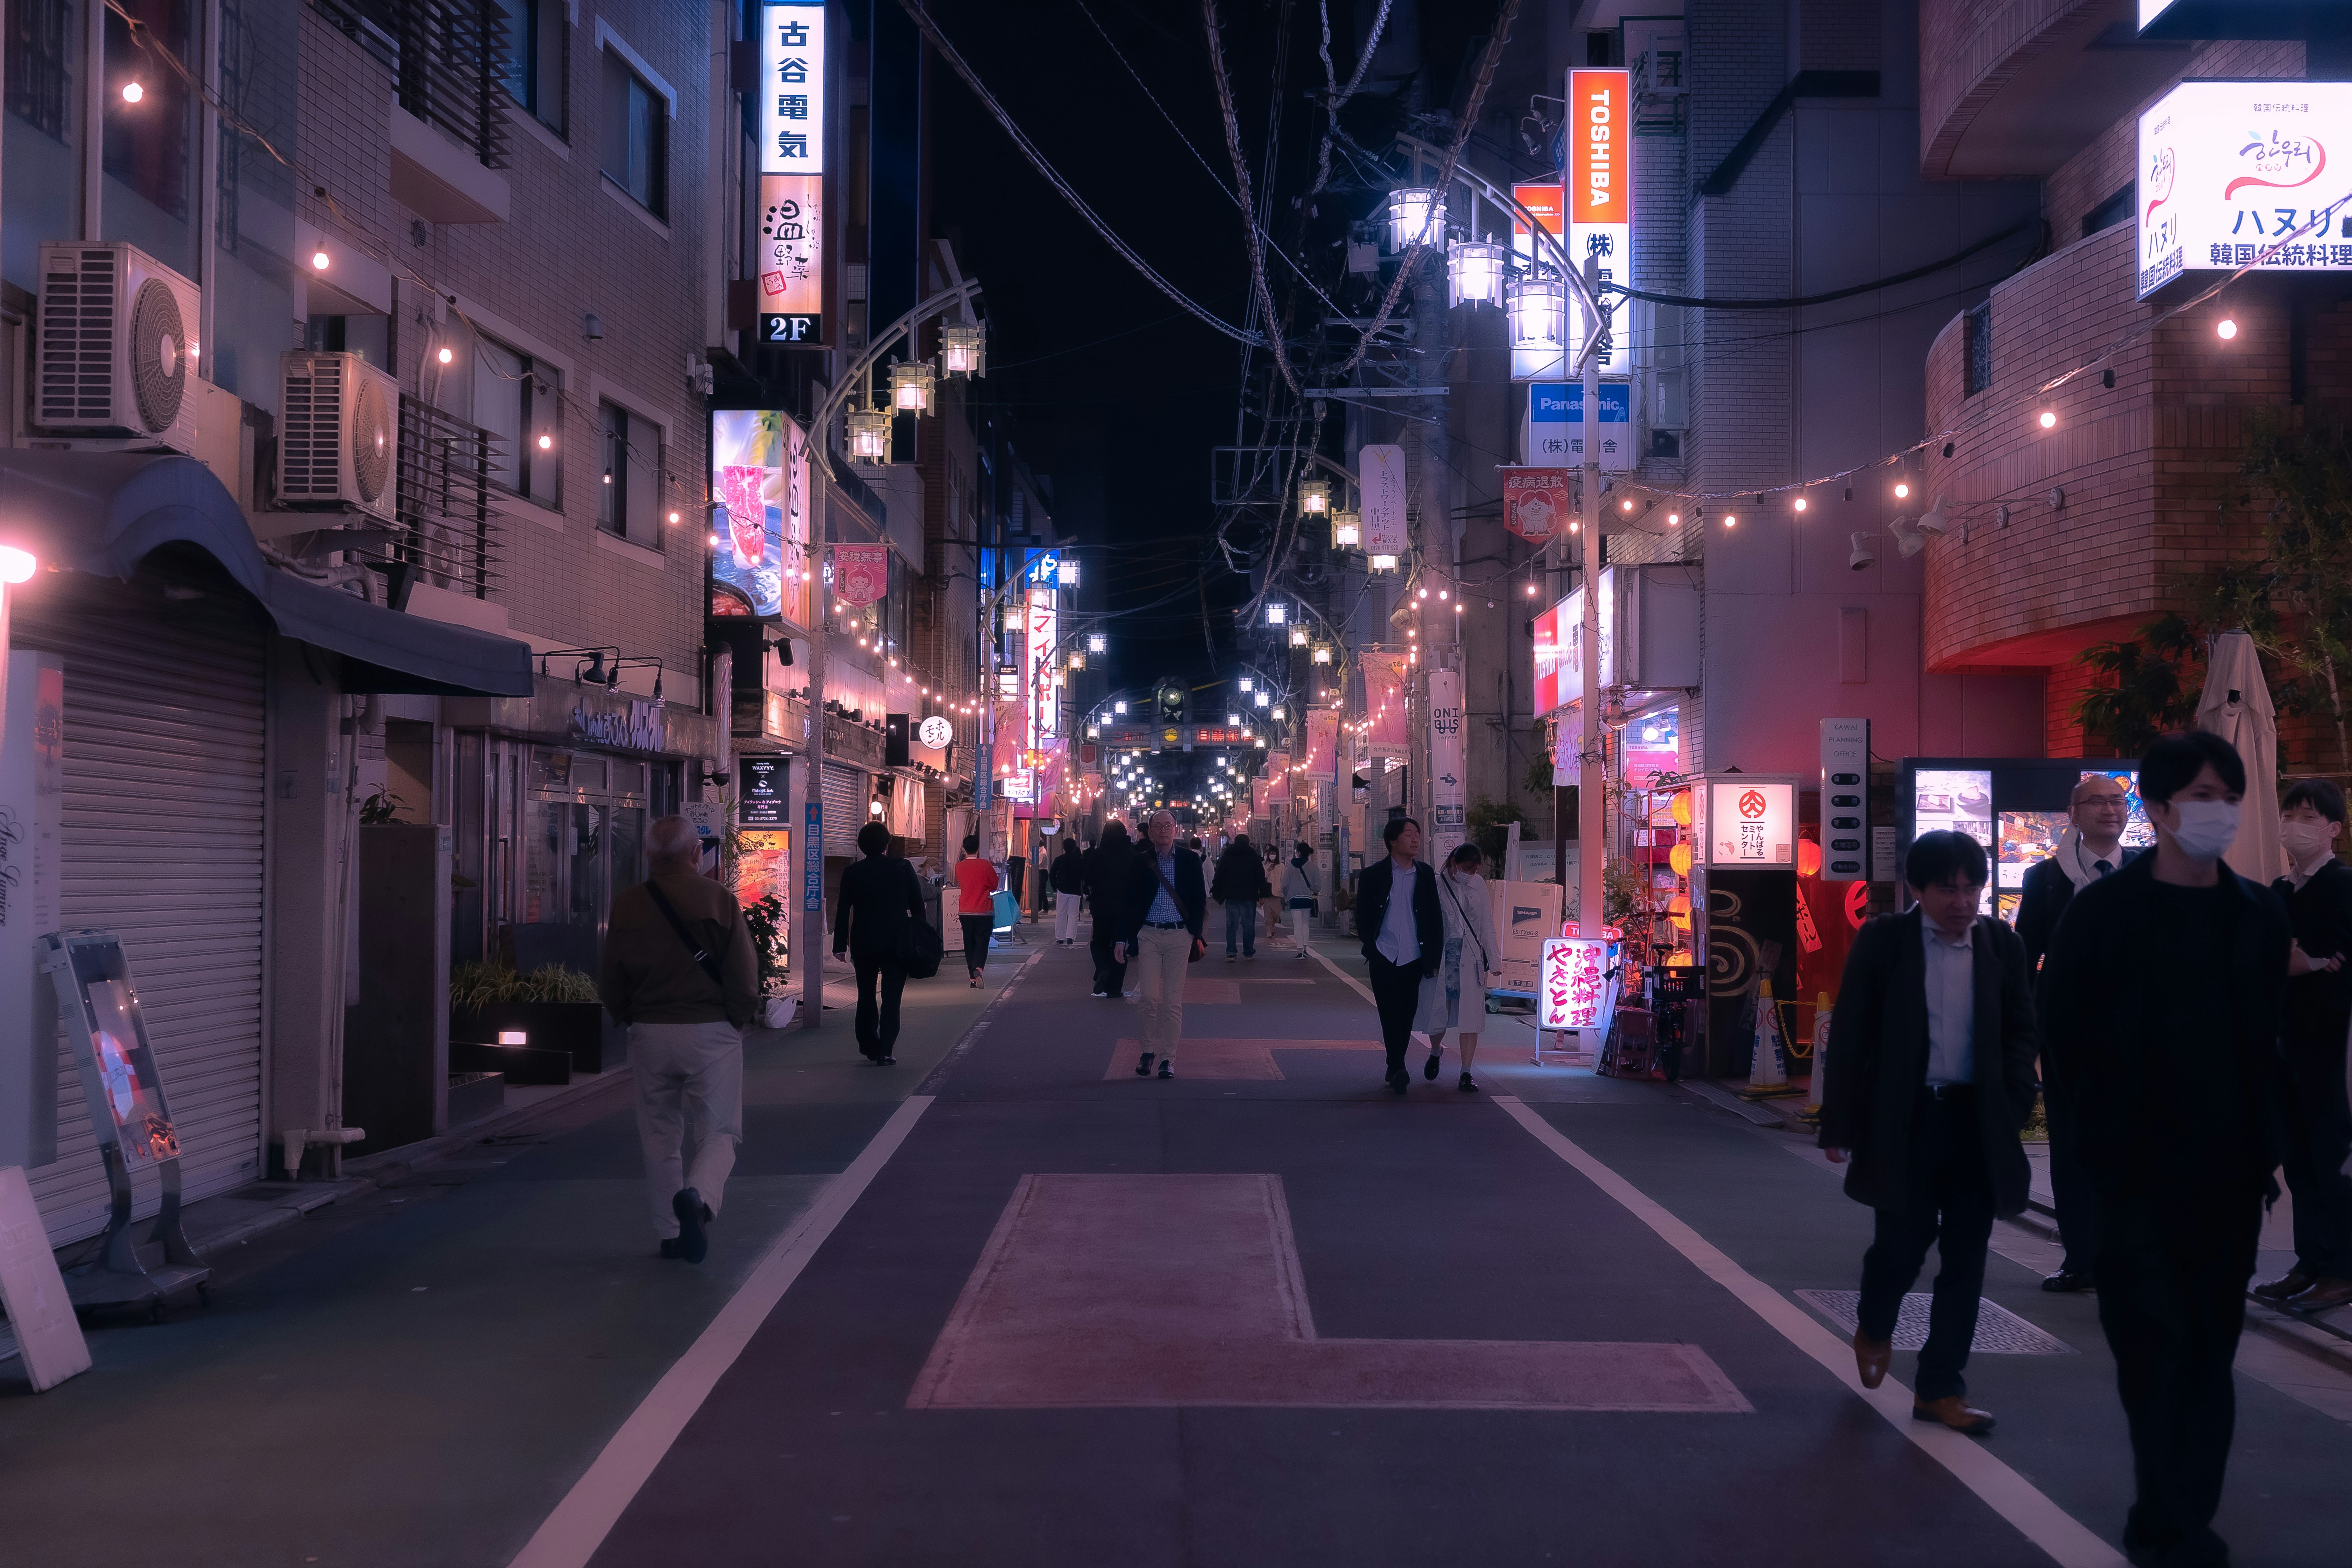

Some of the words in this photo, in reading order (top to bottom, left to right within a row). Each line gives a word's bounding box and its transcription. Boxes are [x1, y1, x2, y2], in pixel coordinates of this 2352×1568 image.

[777, 20, 809, 158] 古谷電気
[2253, 103, 2309, 112] 韓国伝統料理
[1590, 89, 1610, 207] TOSHIBA
[2149, 213, 2176, 259] ハヌリ
[2232, 209, 2331, 238] ハヌリ
[762, 199, 809, 280] 温野菜
[2141, 245, 2183, 291] 韓国伝統料理
[2210, 242, 2352, 267] 韓国伝統料理
[770, 317, 811, 341] 2F
[1541, 397, 1619, 410] Panasnic
[783, 421, 789, 452] 2F
[1542, 438, 1617, 454] (株)電舎
[1508, 475, 1564, 489] 疫病退散
[1380, 470, 1389, 530] トラストワークアウト
[1370, 507, 1380, 531] 中目黒
[838, 550, 884, 563] 安穏無事
[1434, 708, 1459, 718] ONI
[1434, 719, 1459, 733] BUS
[806, 824, 820, 909] 目黒区総合庁舎
[1546, 943, 1572, 1024] やきとん
[1570, 944, 1602, 1026] 沖縄料理
